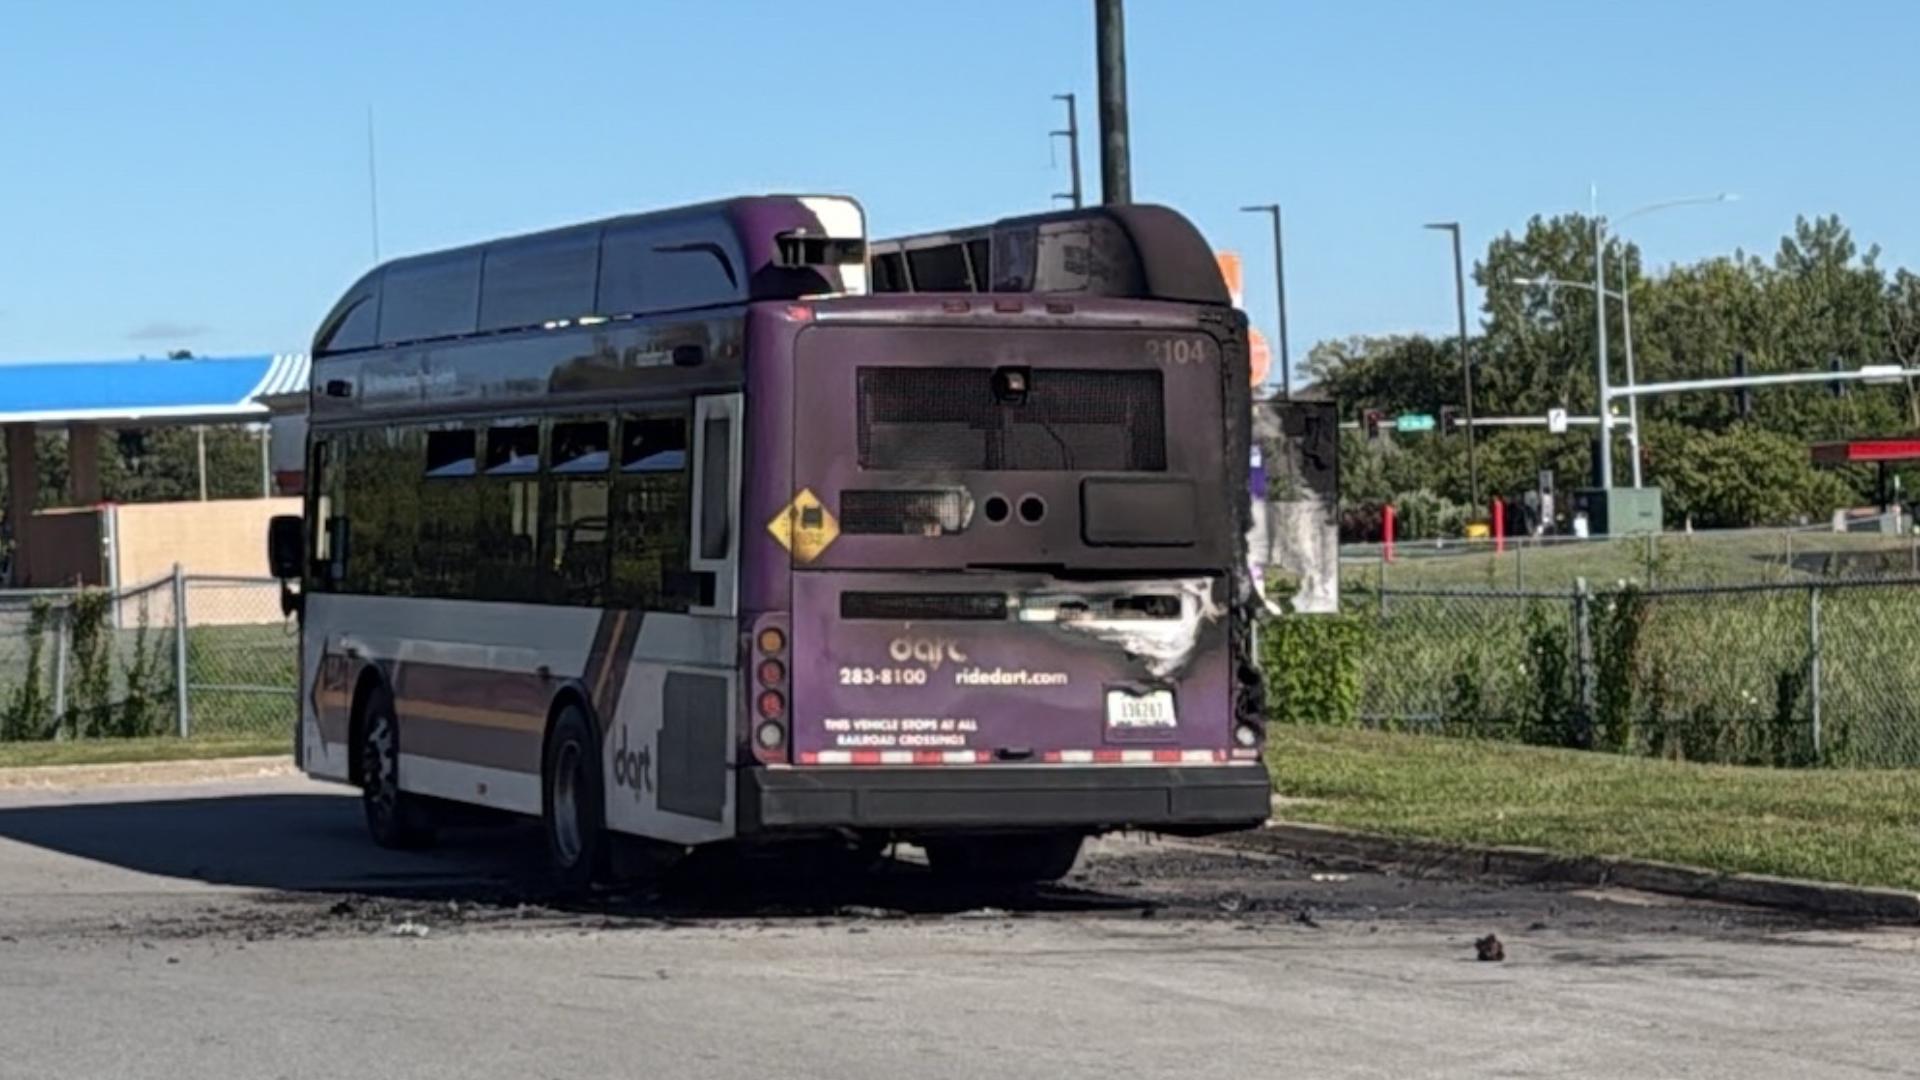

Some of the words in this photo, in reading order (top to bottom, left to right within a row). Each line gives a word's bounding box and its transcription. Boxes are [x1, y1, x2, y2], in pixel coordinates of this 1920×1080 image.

[839, 667, 927, 685] 283-8100
[955, 667, 1068, 685] ridedart.com
[824, 718, 850, 731] THIS
[853, 719, 898, 731] VEHICLE
[901, 719, 937, 731] STOPS
[940, 719, 955, 731] AT
[957, 719, 978, 732] ALL
[837, 734, 896, 746] RAILROAD
[899, 734, 966, 746] CROSSINGS
[614, 722, 653, 803] dart
